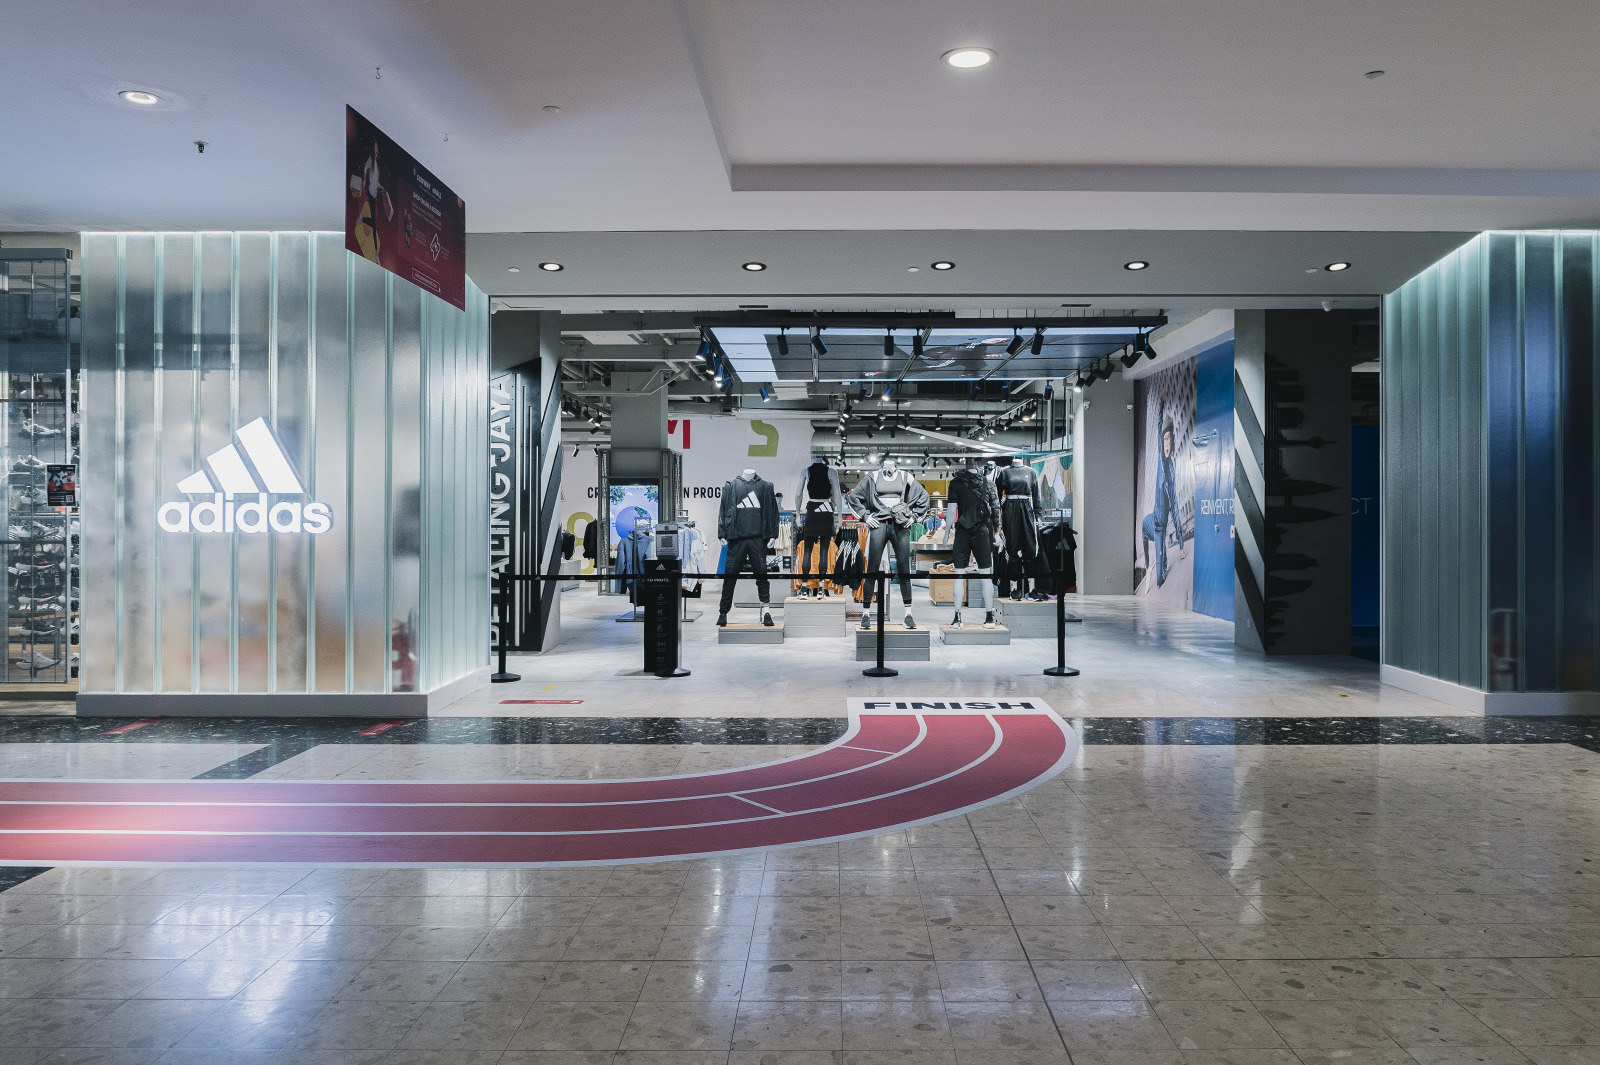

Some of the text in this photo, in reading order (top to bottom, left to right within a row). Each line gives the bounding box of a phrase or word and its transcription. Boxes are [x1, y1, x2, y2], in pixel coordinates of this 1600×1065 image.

[491, 373, 511, 467] JAYA
[693, 486, 721, 499] PROG
[157, 492, 332, 534] adidas
[864, 702, 1036, 710] FINISH
